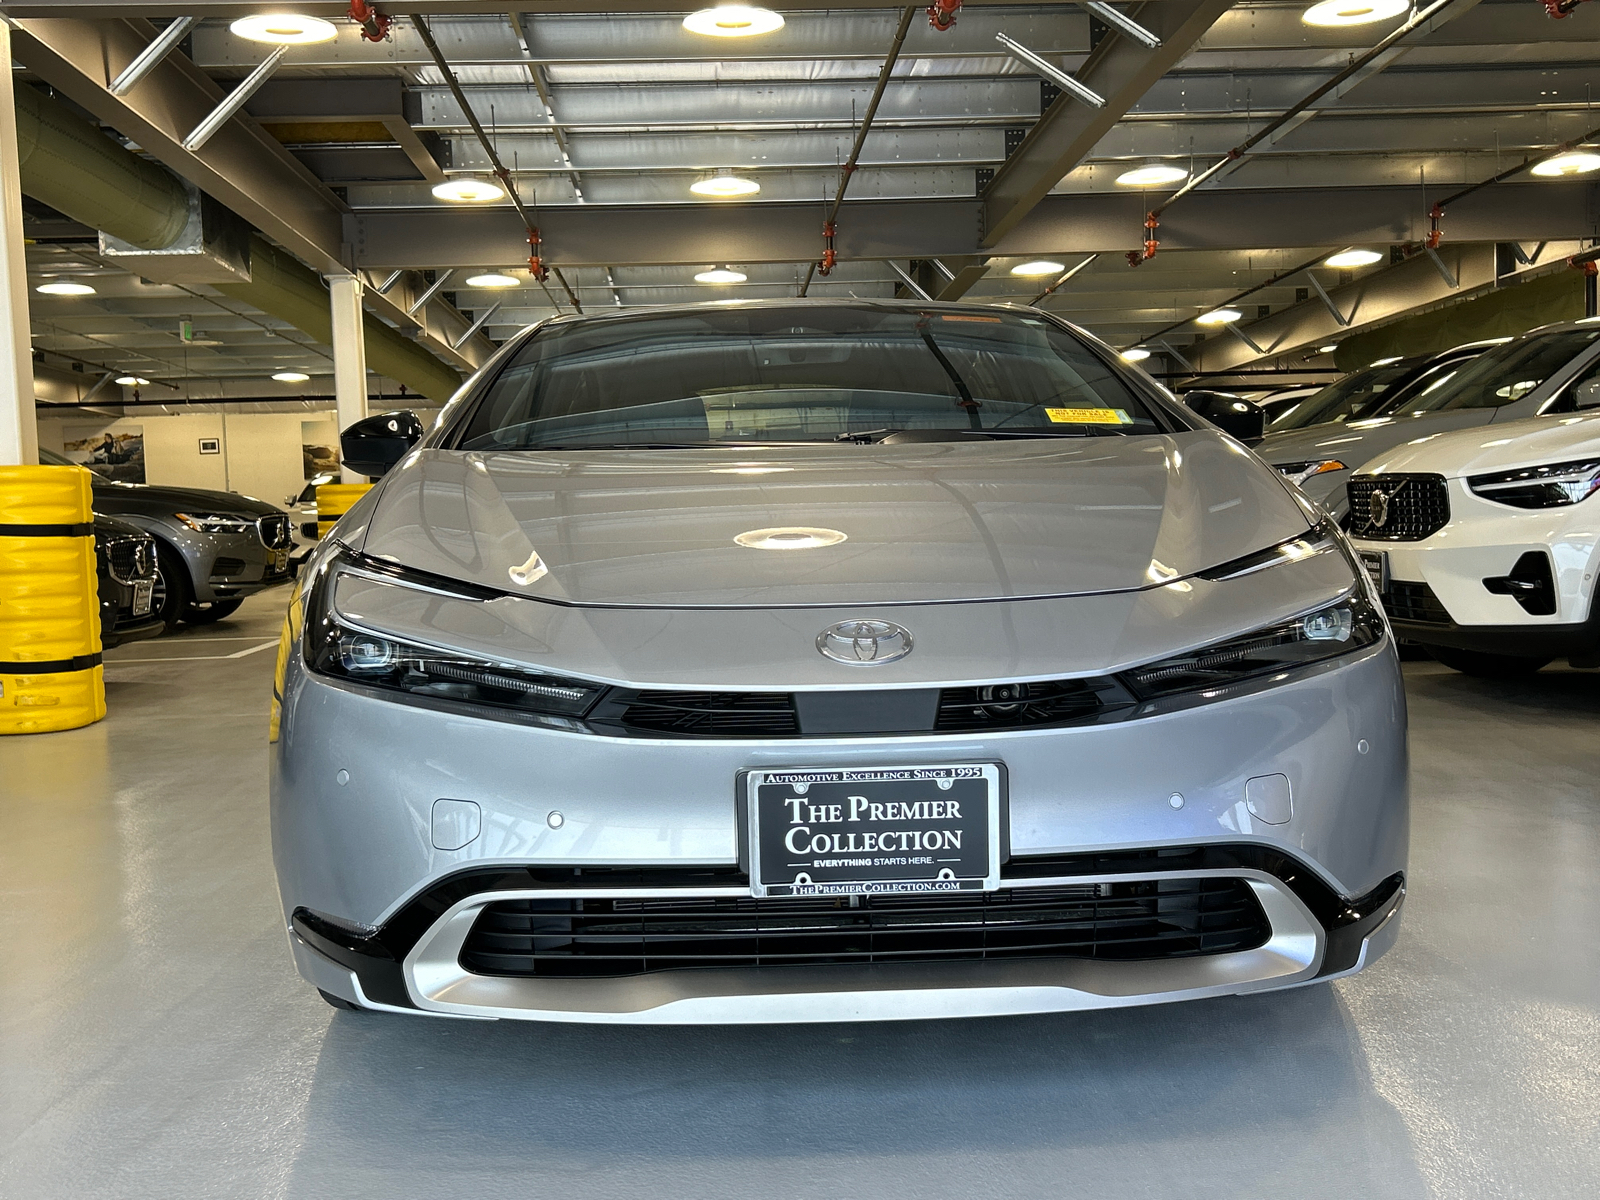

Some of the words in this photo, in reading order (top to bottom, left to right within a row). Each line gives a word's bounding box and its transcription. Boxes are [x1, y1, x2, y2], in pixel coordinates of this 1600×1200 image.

[766, 773, 839, 783] AUTOMOTIVE
[842, 771, 910, 781] EXCELLENCE
[913, 769, 947, 778] SINCE
[950, 767, 980, 777] 1995
[784, 797, 843, 824] THE
[847, 795, 963, 822] PREMIER
[784, 826, 963, 855] COLLECTION
[813, 857, 872, 868] EVERYTHING
[873, 856, 907, 866] STARTS
[908, 855, 934, 865] HERE.
[789, 882, 960, 895] THEPREMIERCOLLECTION.COM
